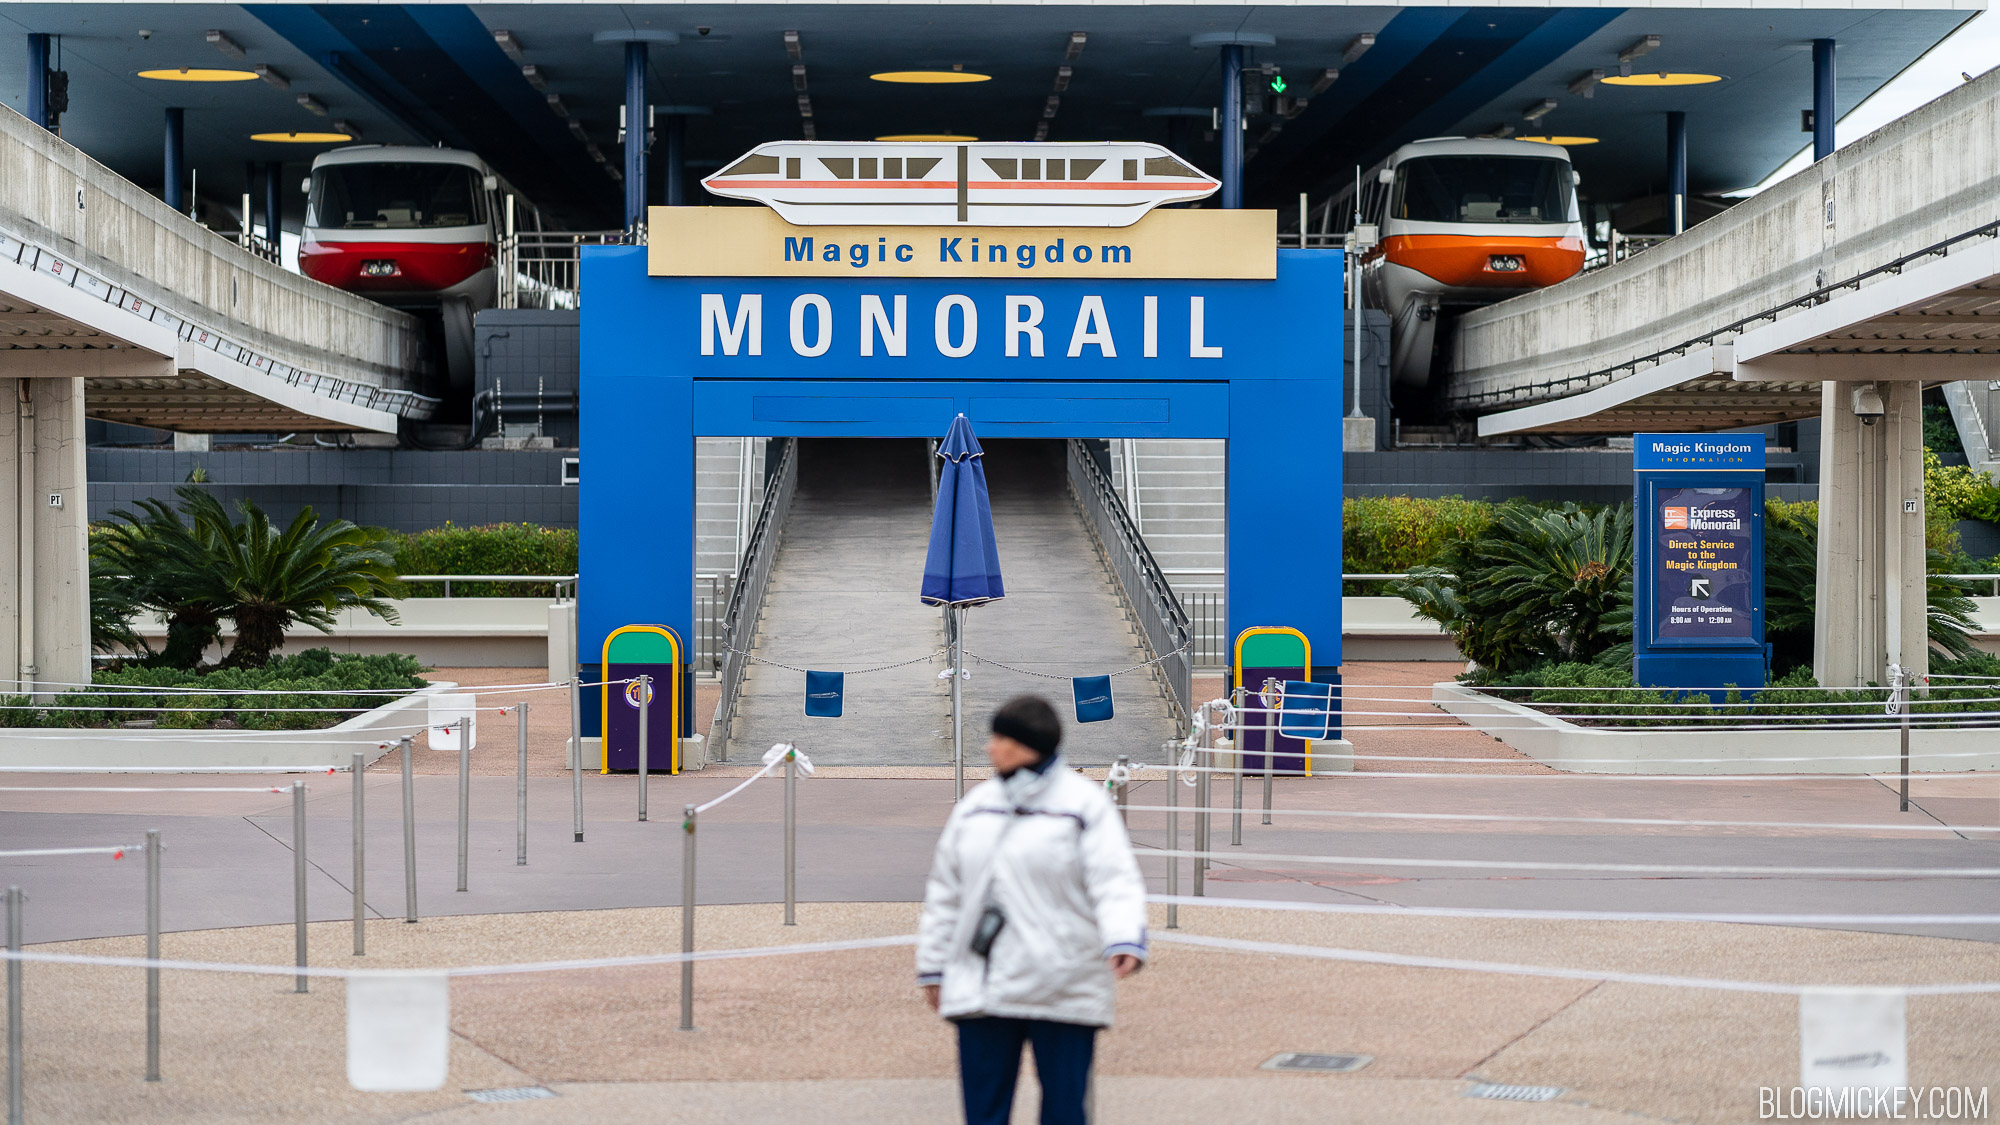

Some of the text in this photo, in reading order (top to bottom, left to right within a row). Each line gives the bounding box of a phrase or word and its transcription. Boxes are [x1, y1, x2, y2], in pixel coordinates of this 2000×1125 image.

[784, 236, 1133, 269] Magic Kingdom
[700, 293, 1224, 358] MONORAIL
[1652, 442, 1752, 455] Magic Kingdom
[50, 495, 61, 505] PT
[1905, 501, 1915, 511] PT
[1690, 506, 1736, 520] Express
[1690, 518, 1741, 530] Monorail
[1668, 539, 1735, 549] Direct Service
[1687, 550, 1716, 559] to the
[1666, 560, 1738, 571] Magic Kingdom
[1671, 605, 1733, 614] Hours of Operation
